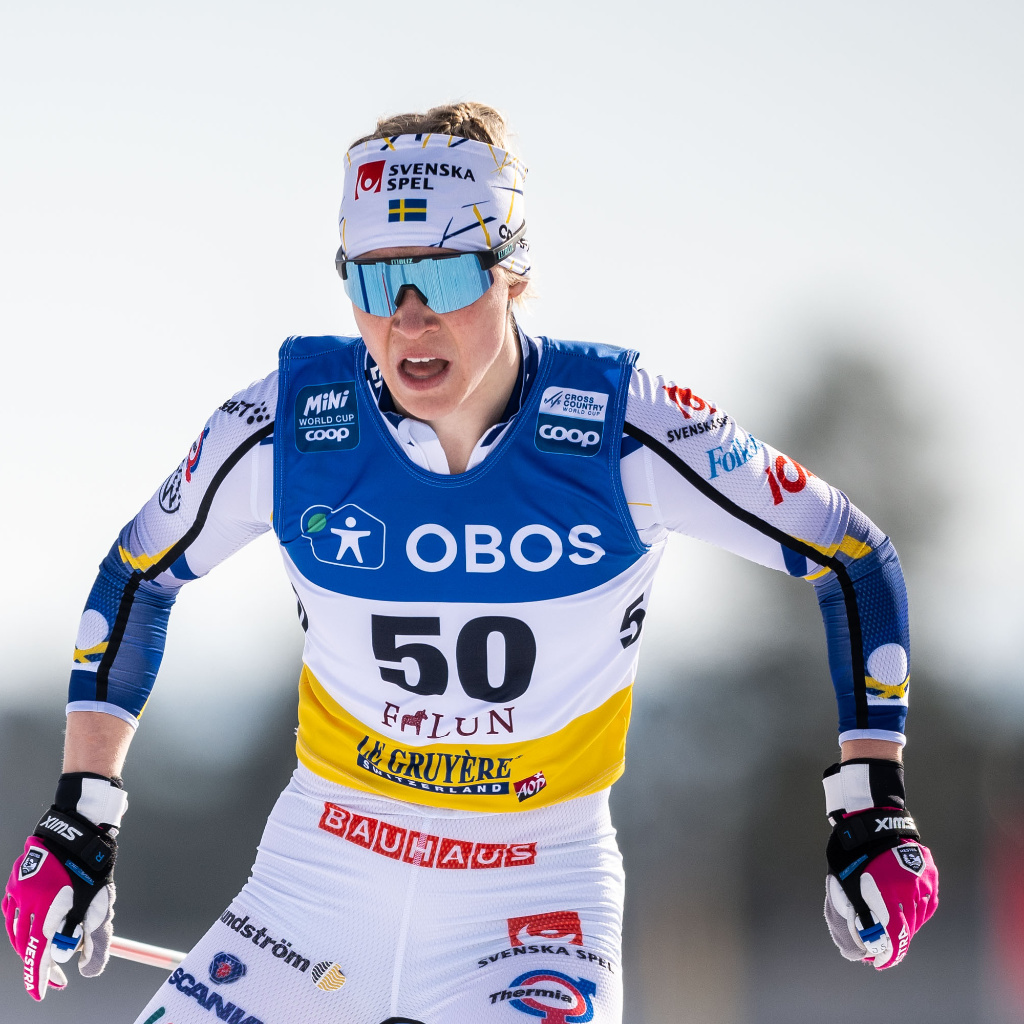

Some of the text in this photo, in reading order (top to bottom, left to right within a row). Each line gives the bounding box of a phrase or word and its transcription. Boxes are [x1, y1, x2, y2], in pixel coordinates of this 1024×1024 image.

[387, 177, 434, 191] SPEL
[388, 163, 476, 183] SVENSKA
[563, 400, 604, 412] COUNTRY
[564, 394, 594, 404] CROSS
[298, 413, 355, 426] WORLD CUP
[563, 407, 585, 415] WORLD
[305, 427, 350, 442] coop
[538, 424, 600, 447] coop
[667, 421, 717, 443] SVENSKA
[405, 523, 606, 574] OBOS
[371, 613, 537, 704] 50
[357, 735, 514, 785] LE GRUYÈRE
[361, 758, 504, 794] SWITZERLAND
[516, 777, 547, 799] AOP
[39, 815, 83, 841] SWIX
[320, 803, 536, 868] BAUHAUS
[875, 817, 917, 832] SWIX
[24, 935, 40, 991] HESTRA
[477, 945, 615, 975] SVENSKA SPEL
[489, 987, 573, 1005] Thermia
